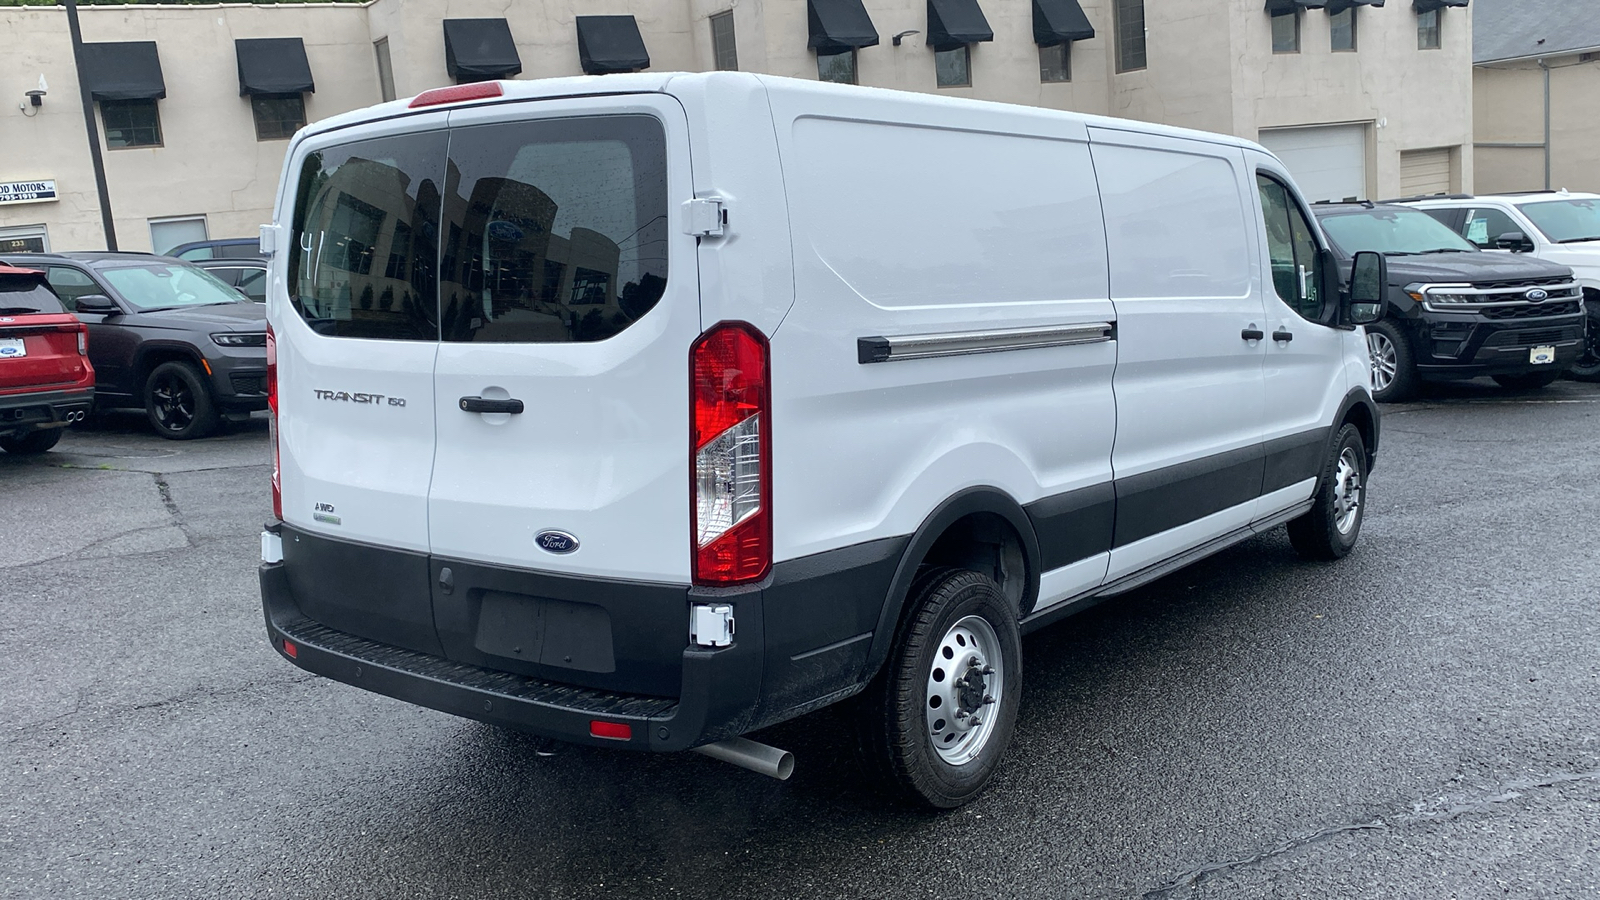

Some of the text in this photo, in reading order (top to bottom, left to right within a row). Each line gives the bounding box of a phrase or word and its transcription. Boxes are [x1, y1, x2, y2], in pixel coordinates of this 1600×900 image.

[300, 230, 325, 287] 41
[313, 389, 407, 407] TRANSIT 150
[314, 502, 334, 512] AWD
[542, 535, 567, 549] Ford
